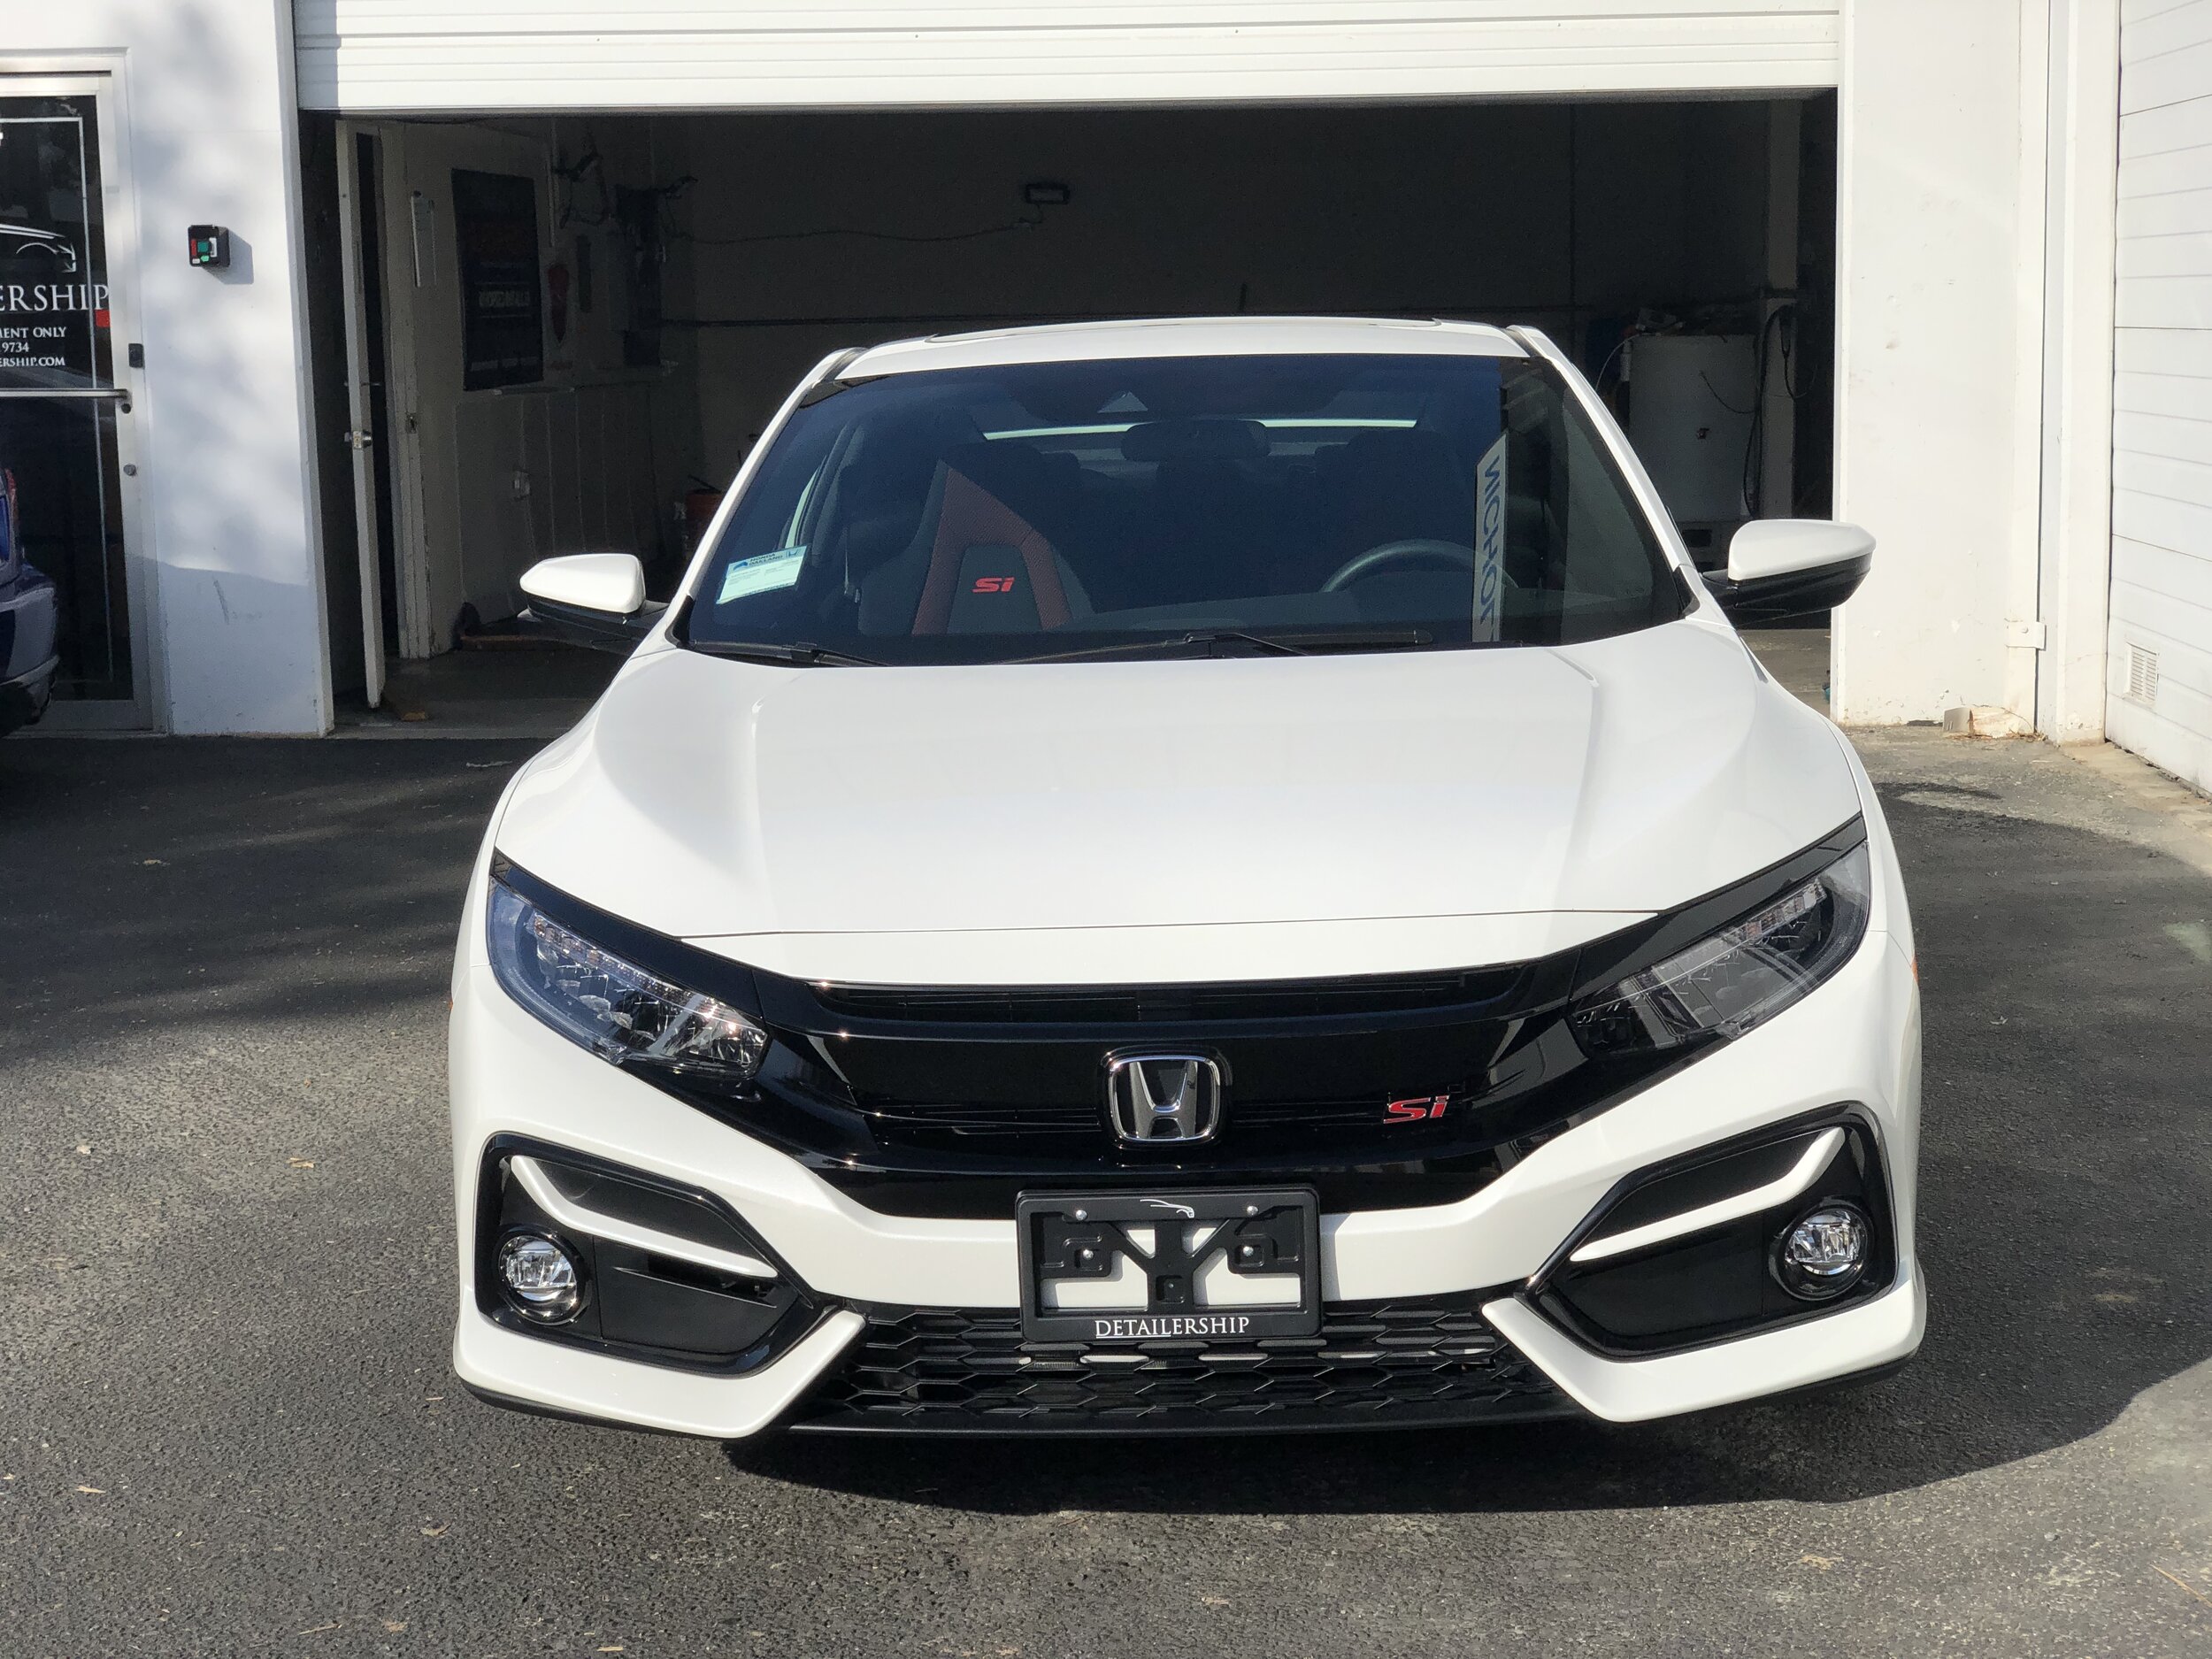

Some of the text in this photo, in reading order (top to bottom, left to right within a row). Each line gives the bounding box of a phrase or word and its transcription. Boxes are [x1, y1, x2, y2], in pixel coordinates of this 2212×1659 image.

[0, 326, 66, 339] ENT ONLY
[2, 342, 29, 353] 9734
[1383, 1095, 1450, 1125] Si
[1094, 1317, 1250, 1338] DETAILERSHIP
